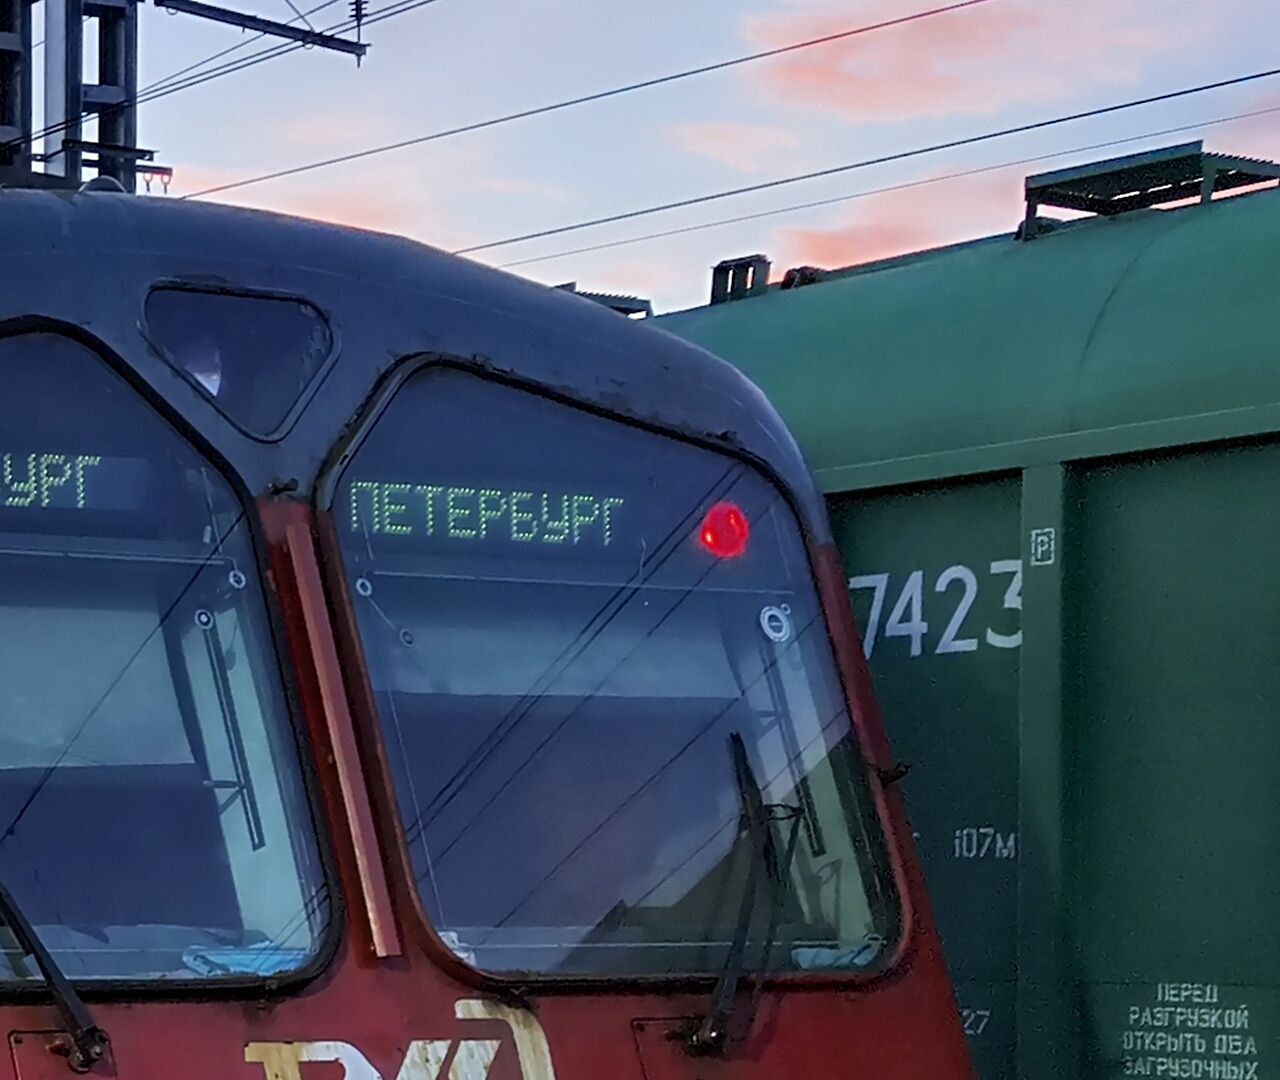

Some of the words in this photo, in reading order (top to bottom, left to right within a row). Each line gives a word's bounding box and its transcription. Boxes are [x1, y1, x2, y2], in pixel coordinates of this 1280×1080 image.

[349, 481, 624, 546] ПЕТЕРБУРГ
[848, 558, 1023, 660] 7423
[1157, 982, 1219, 1003] ПЕРЕД
[1128, 1004, 1249, 1030] РАЗГРУЗКОЙ
[1122, 1031, 1207, 1053] ОТКРЫТЬ
[1214, 1034, 1258, 1055] ДВА
